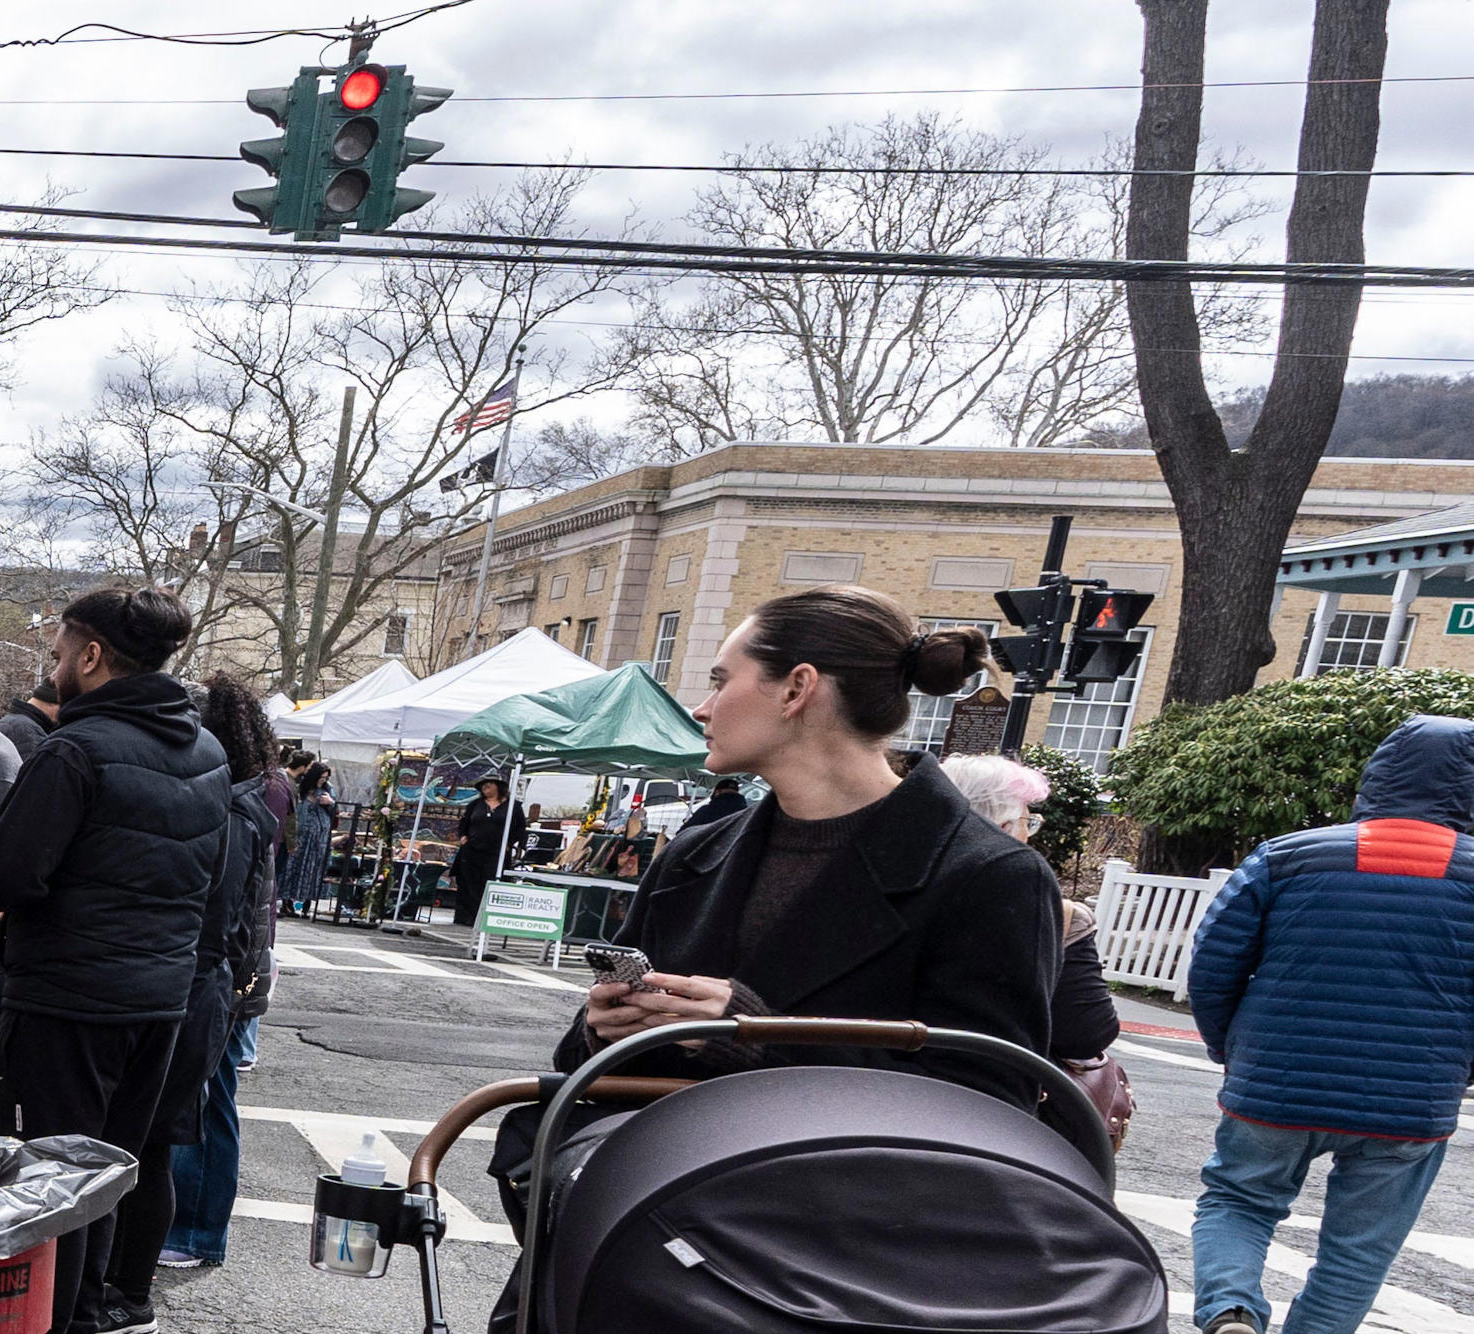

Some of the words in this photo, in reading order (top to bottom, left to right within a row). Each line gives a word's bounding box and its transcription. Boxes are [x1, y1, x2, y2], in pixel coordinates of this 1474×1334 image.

[528, 896, 554, 906] RAND
[527, 903, 561, 913] REALTY
[496, 918, 525, 928] OFFICE
[526, 921, 550, 931] OPEN
